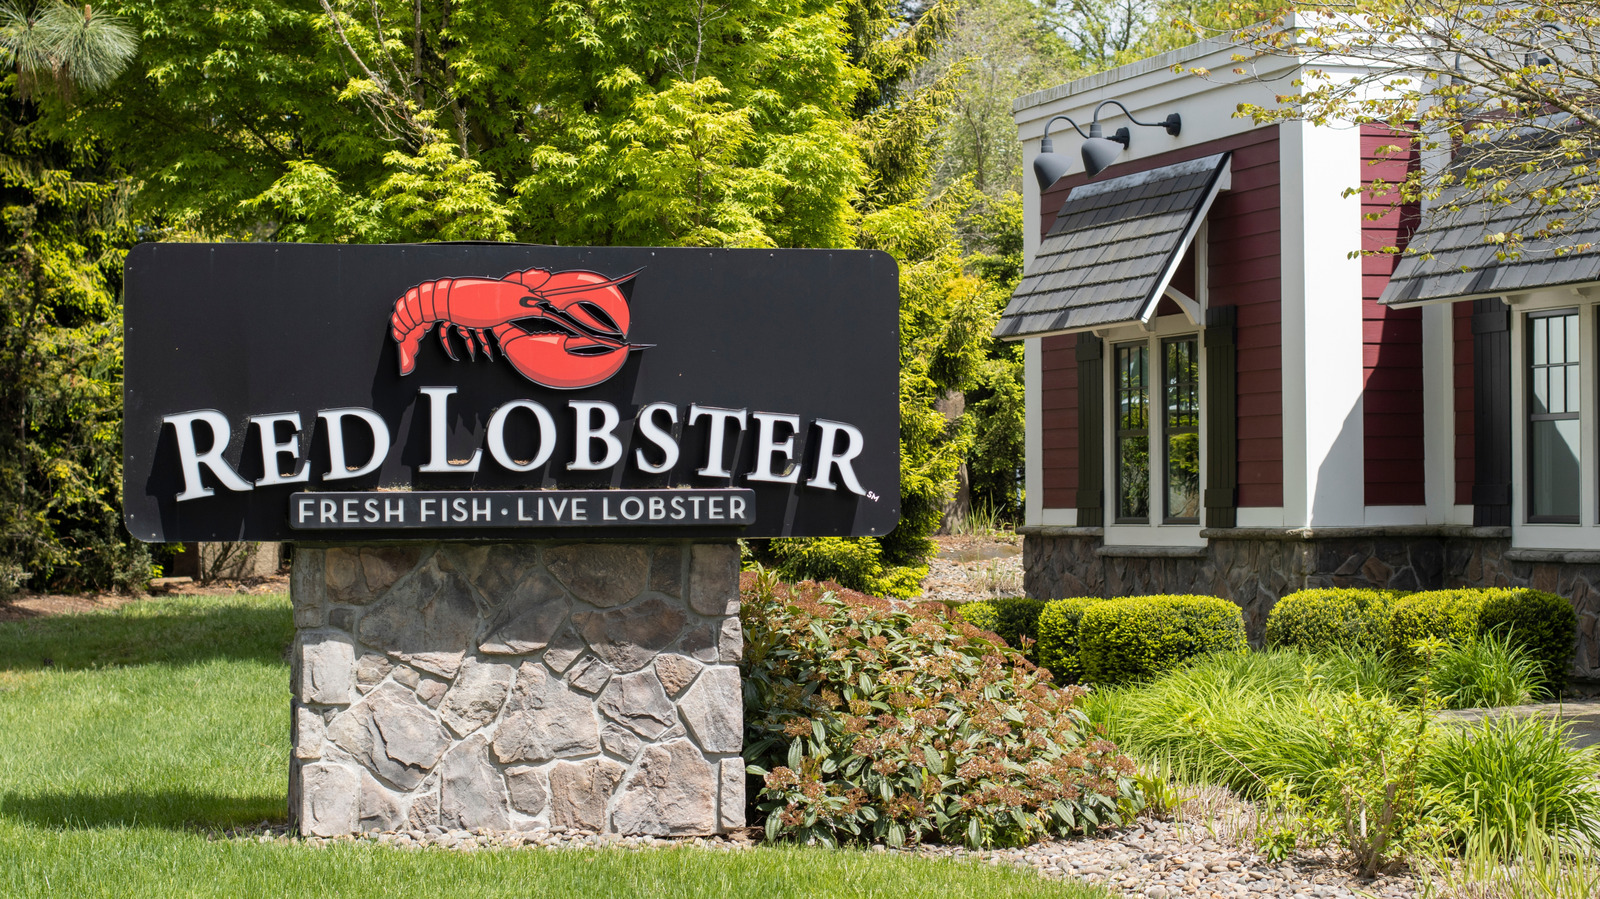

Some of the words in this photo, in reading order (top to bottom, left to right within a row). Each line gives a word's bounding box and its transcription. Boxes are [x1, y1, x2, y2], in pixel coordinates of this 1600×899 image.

[162, 407, 391, 502] RED
[418, 386, 867, 497] LOBSTER
[298, 498, 404, 523] FRESH
[420, 497, 492, 523] FISH
[517, 497, 587, 522] LIVE
[602, 495, 747, 521] LOBSTER
